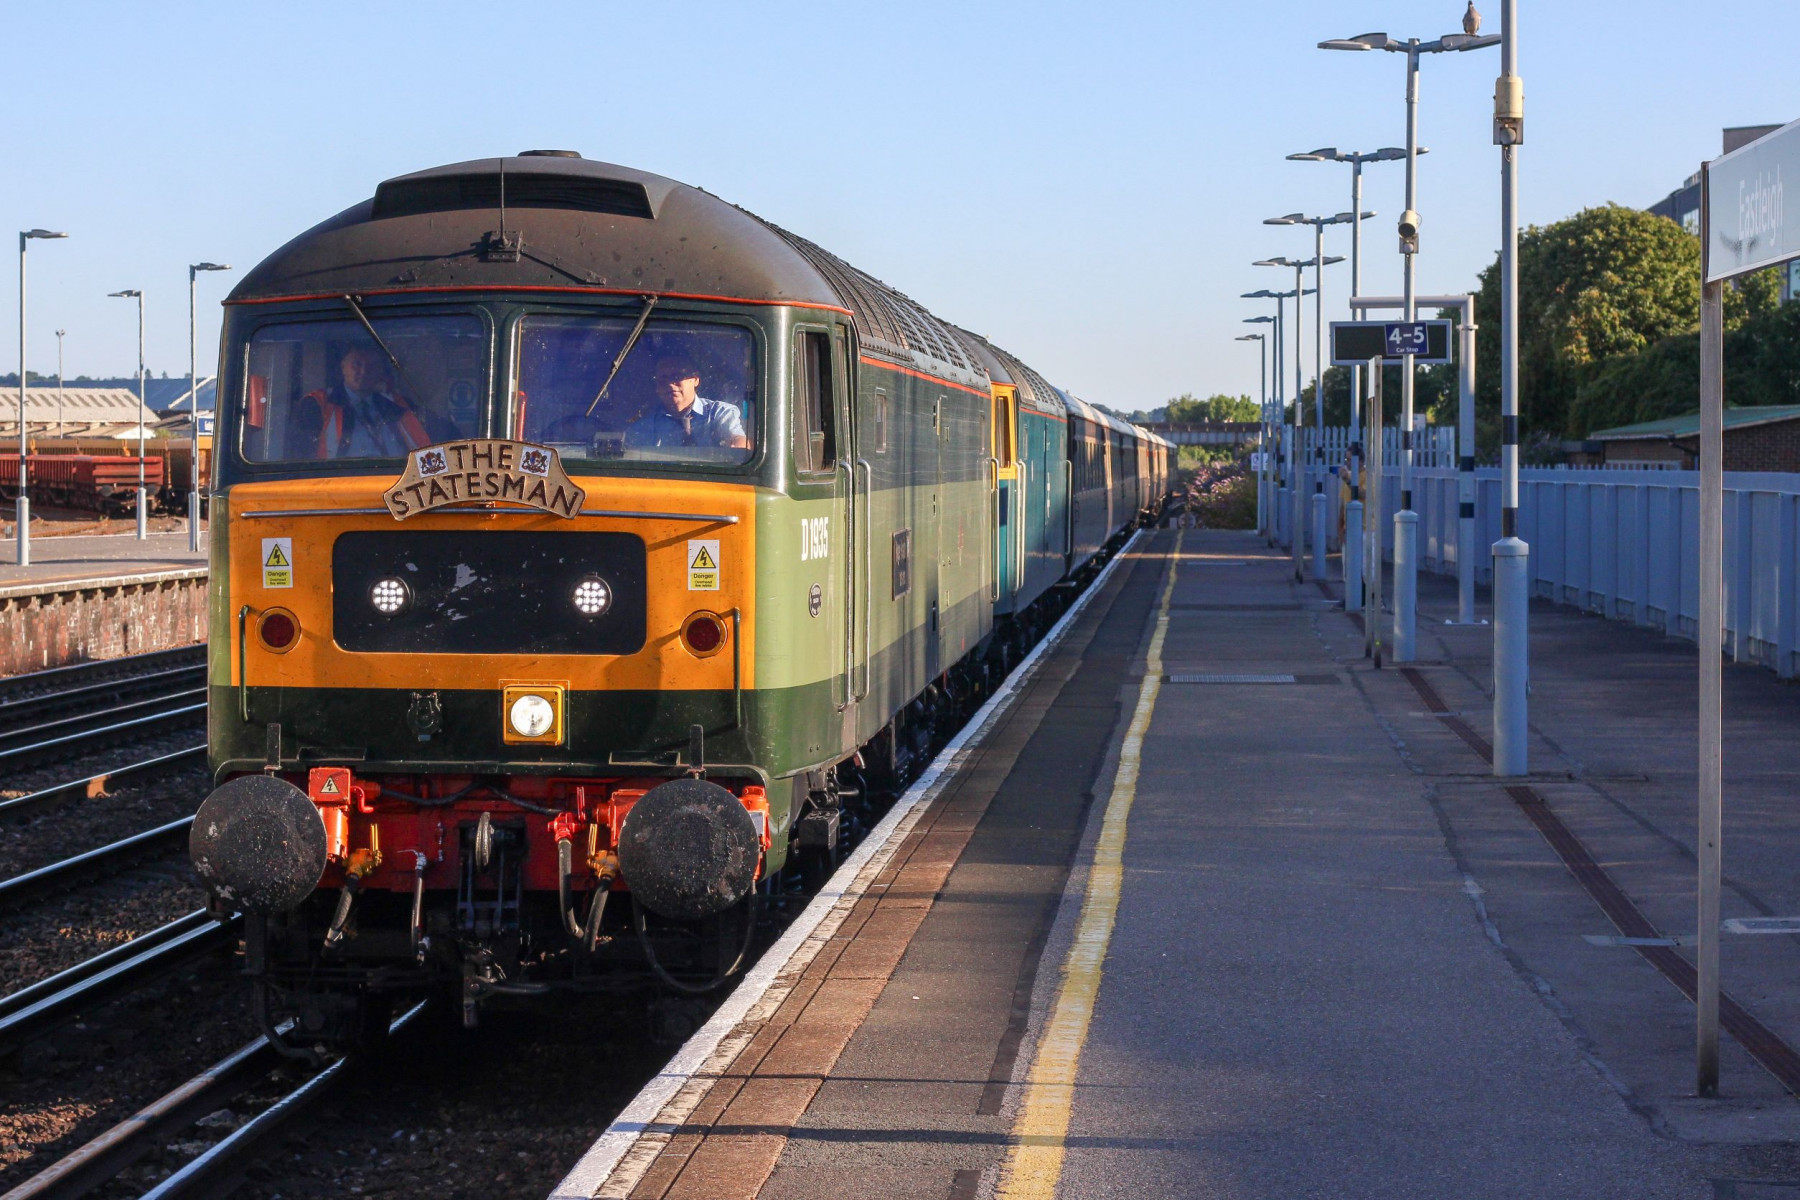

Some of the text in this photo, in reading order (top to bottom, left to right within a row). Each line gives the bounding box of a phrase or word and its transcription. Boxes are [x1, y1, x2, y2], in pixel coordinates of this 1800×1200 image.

[1738, 163, 1783, 247] Eastleigh
[1388, 326, 1425, 344] 4-5
[449, 443, 513, 470] THE
[391, 472, 579, 516] STATESMAN
